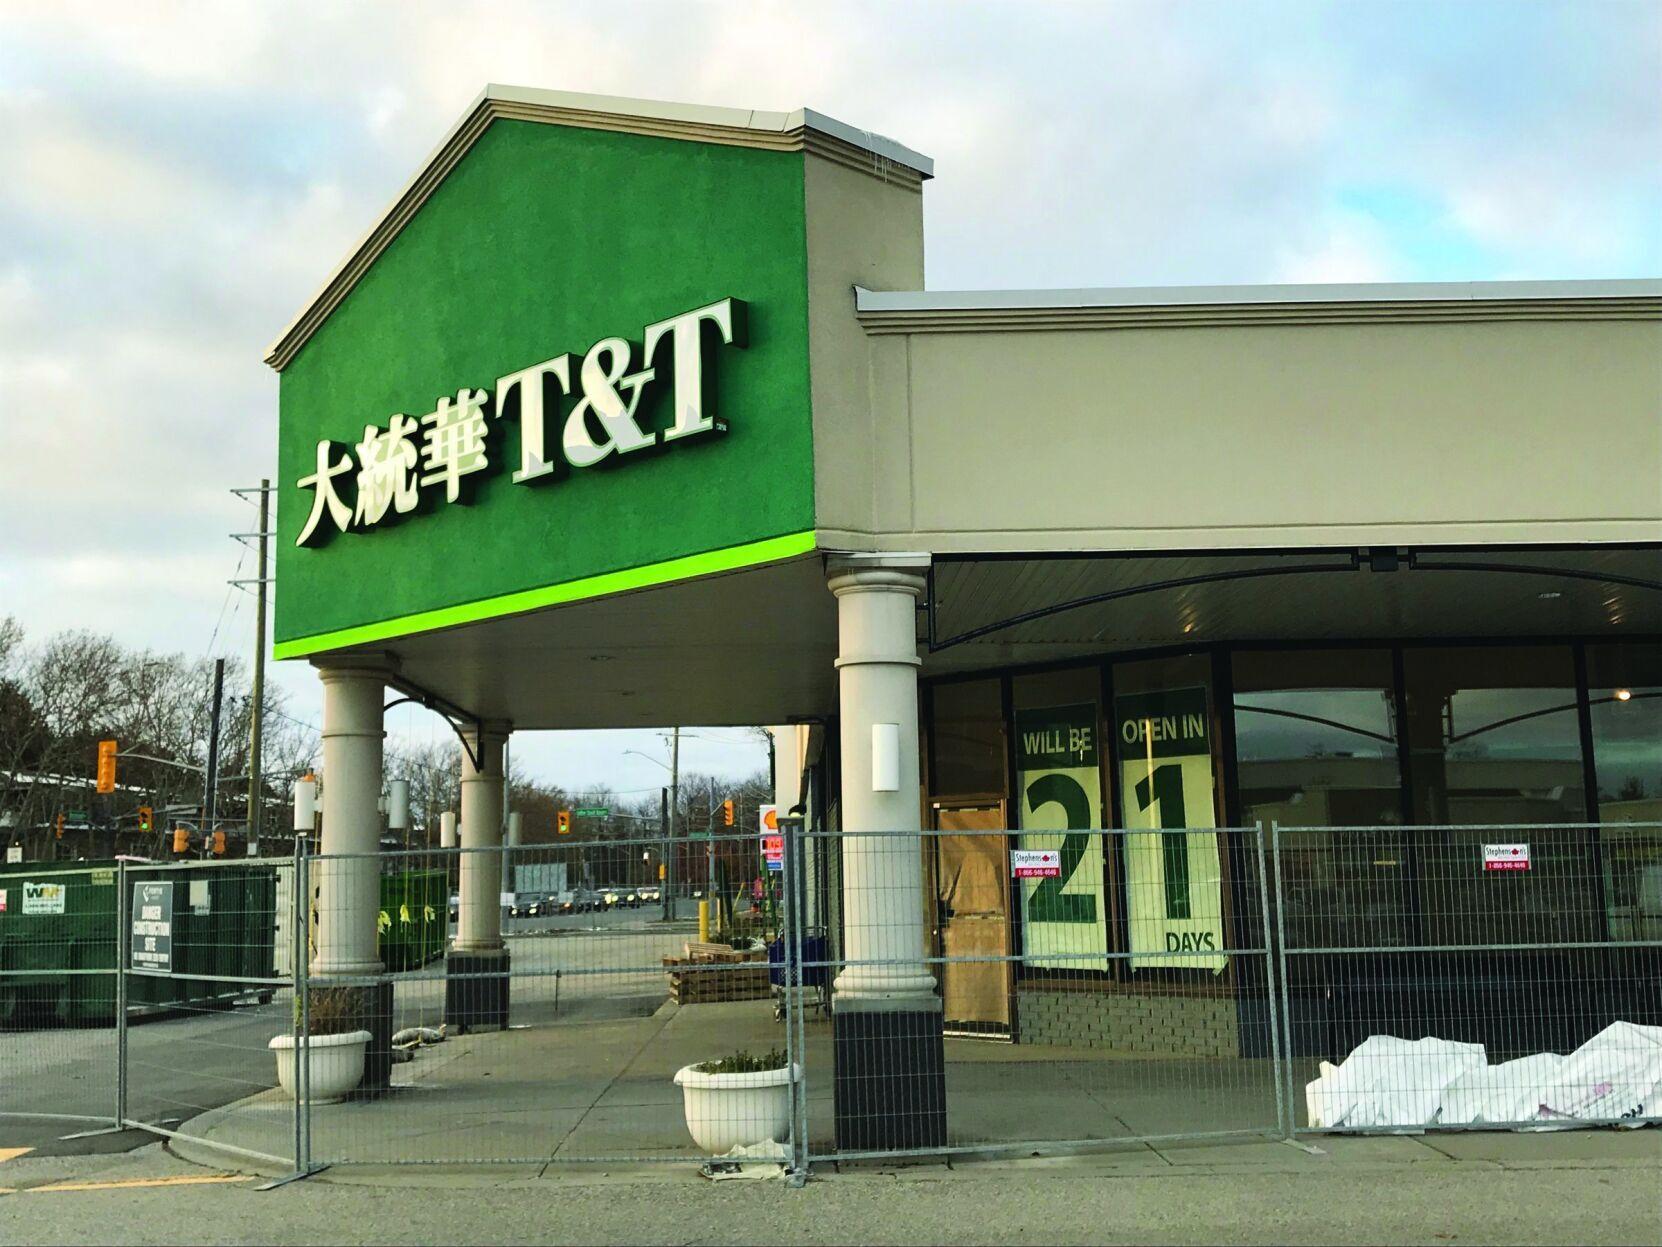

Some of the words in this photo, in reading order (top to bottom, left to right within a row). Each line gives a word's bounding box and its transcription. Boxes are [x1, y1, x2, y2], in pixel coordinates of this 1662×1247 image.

[495, 296, 735, 485] T&T
[295, 387, 490, 548] 大統華
[1023, 730, 1065, 756] WILL
[1069, 726, 1093, 753] BE
[1121, 715, 1177, 745] OPEN
[1182, 712, 1205, 740] IN
[1015, 853, 1058, 863] Stephensn's
[1485, 847, 1526, 856] Stephensn's
[1165, 931, 1216, 954] DAYS
